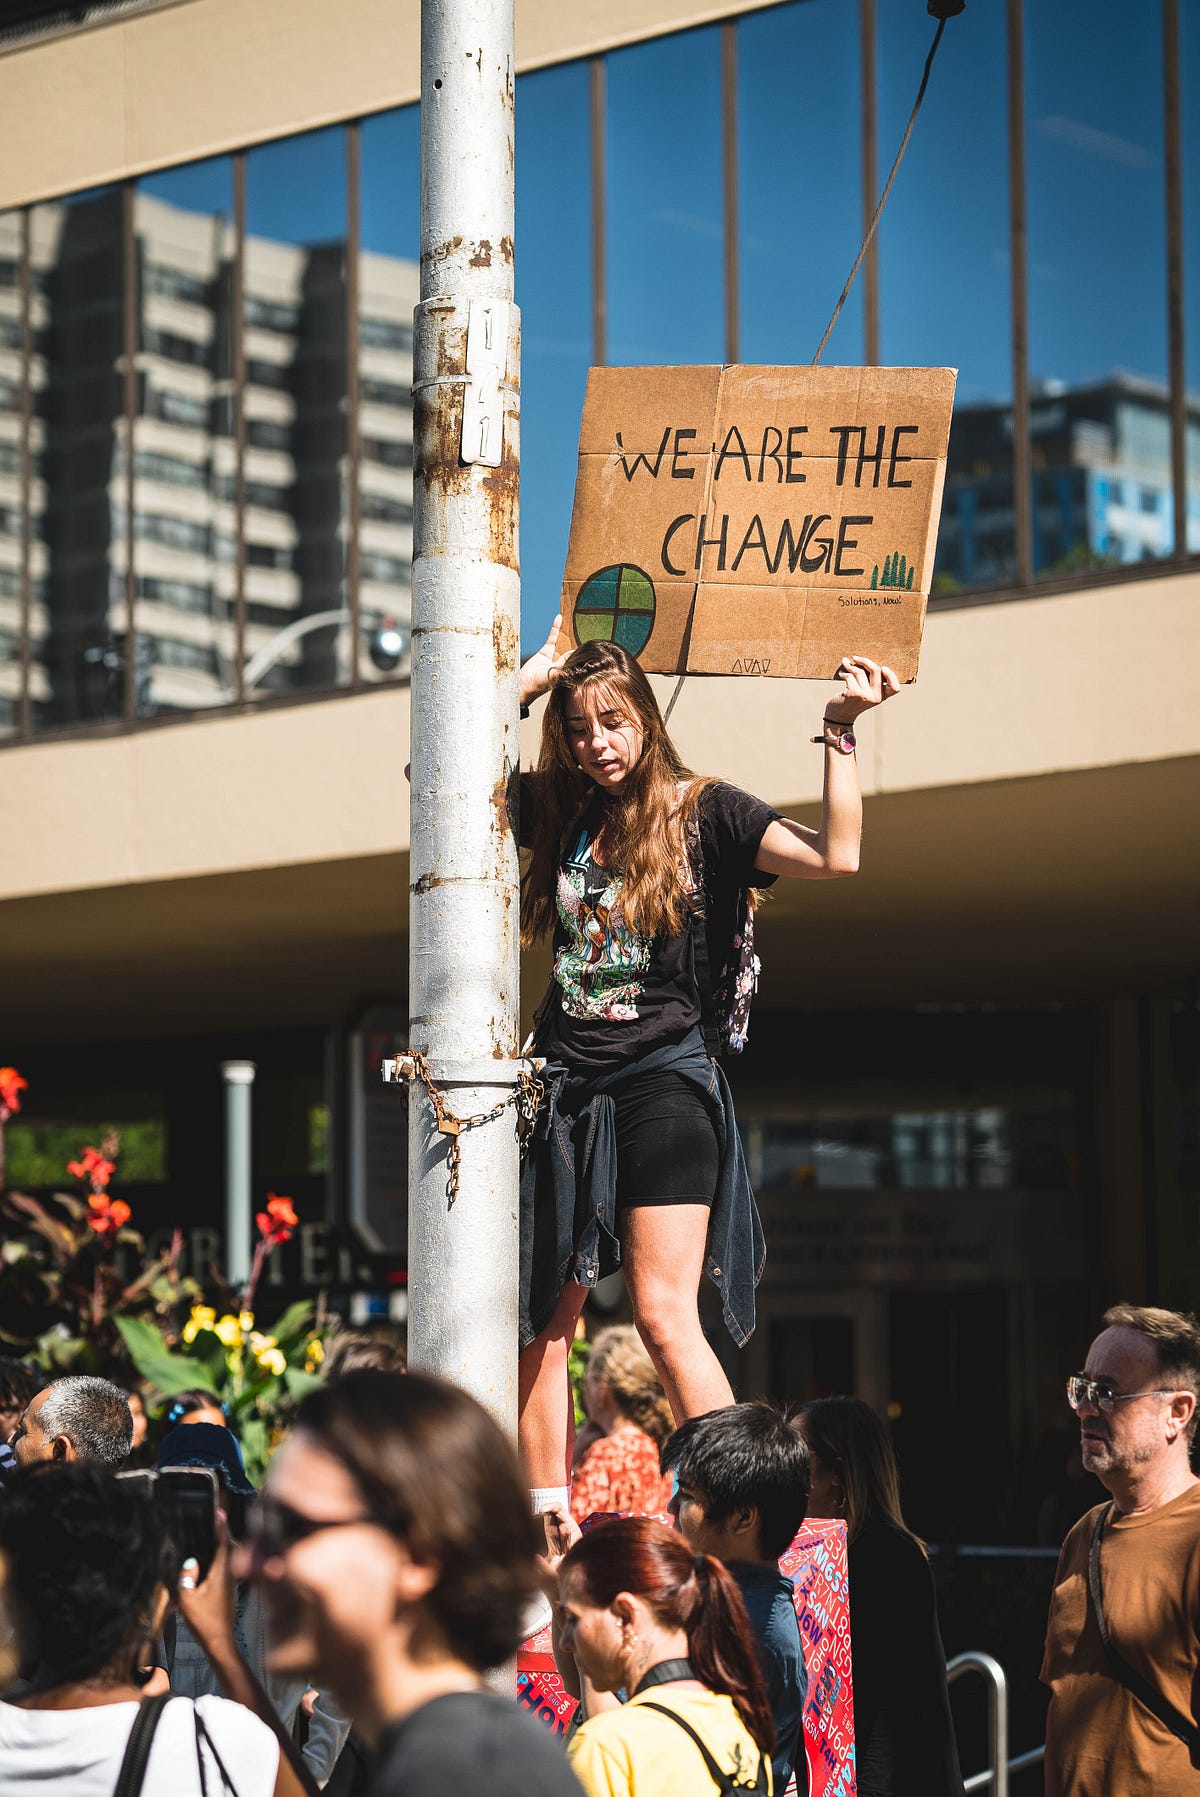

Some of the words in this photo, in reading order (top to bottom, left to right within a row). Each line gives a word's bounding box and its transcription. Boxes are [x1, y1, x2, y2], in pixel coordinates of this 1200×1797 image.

[614, 426, 697, 483] WE
[712, 426, 808, 484] ARE
[829, 425, 918, 488] THE
[661, 513, 873, 577] CHANGE
[838, 595, 880, 607] Solutions,
[814, 1544, 843, 1592] M6S
[797, 1605, 823, 1646] J6W
[806, 1591, 830, 1630] S4N
[819, 1738, 838, 1771] T4H
[827, 1717, 850, 1762] P9A
